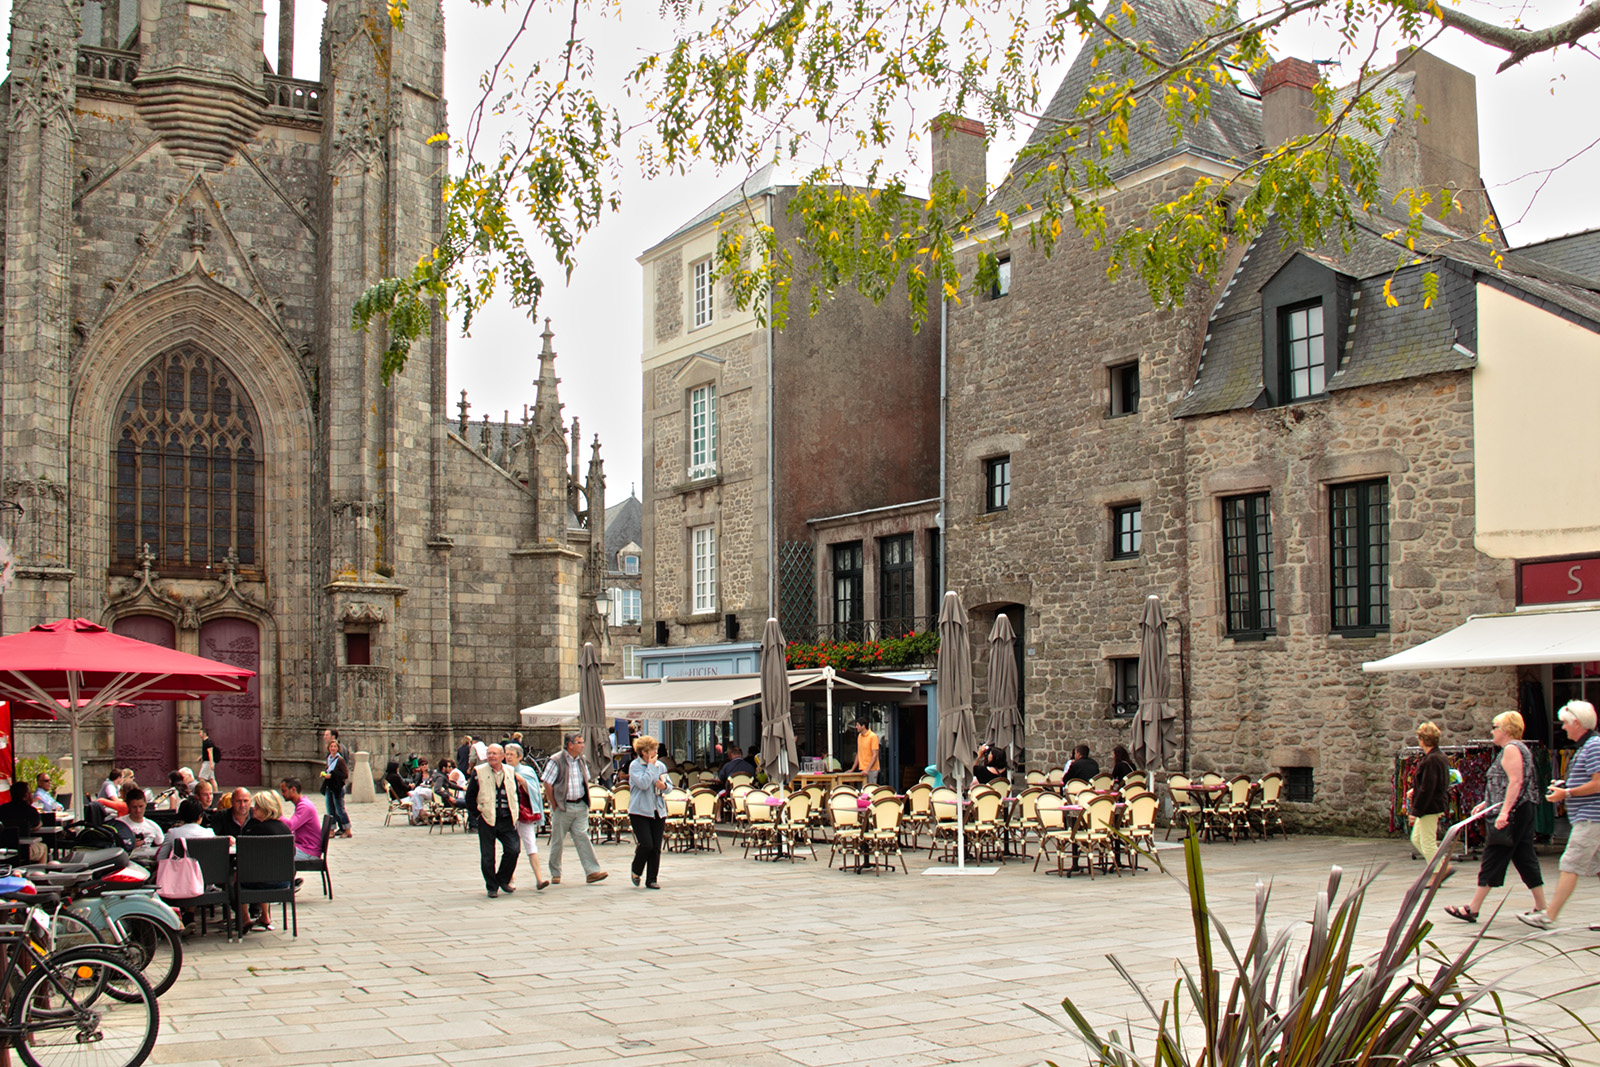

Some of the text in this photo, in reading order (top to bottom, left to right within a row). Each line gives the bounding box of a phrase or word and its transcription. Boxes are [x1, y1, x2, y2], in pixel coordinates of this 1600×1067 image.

[1567, 565, 1583, 595] S
[688, 666, 718, 677] LUCIEN
[676, 710, 720, 719] SALADERIE
